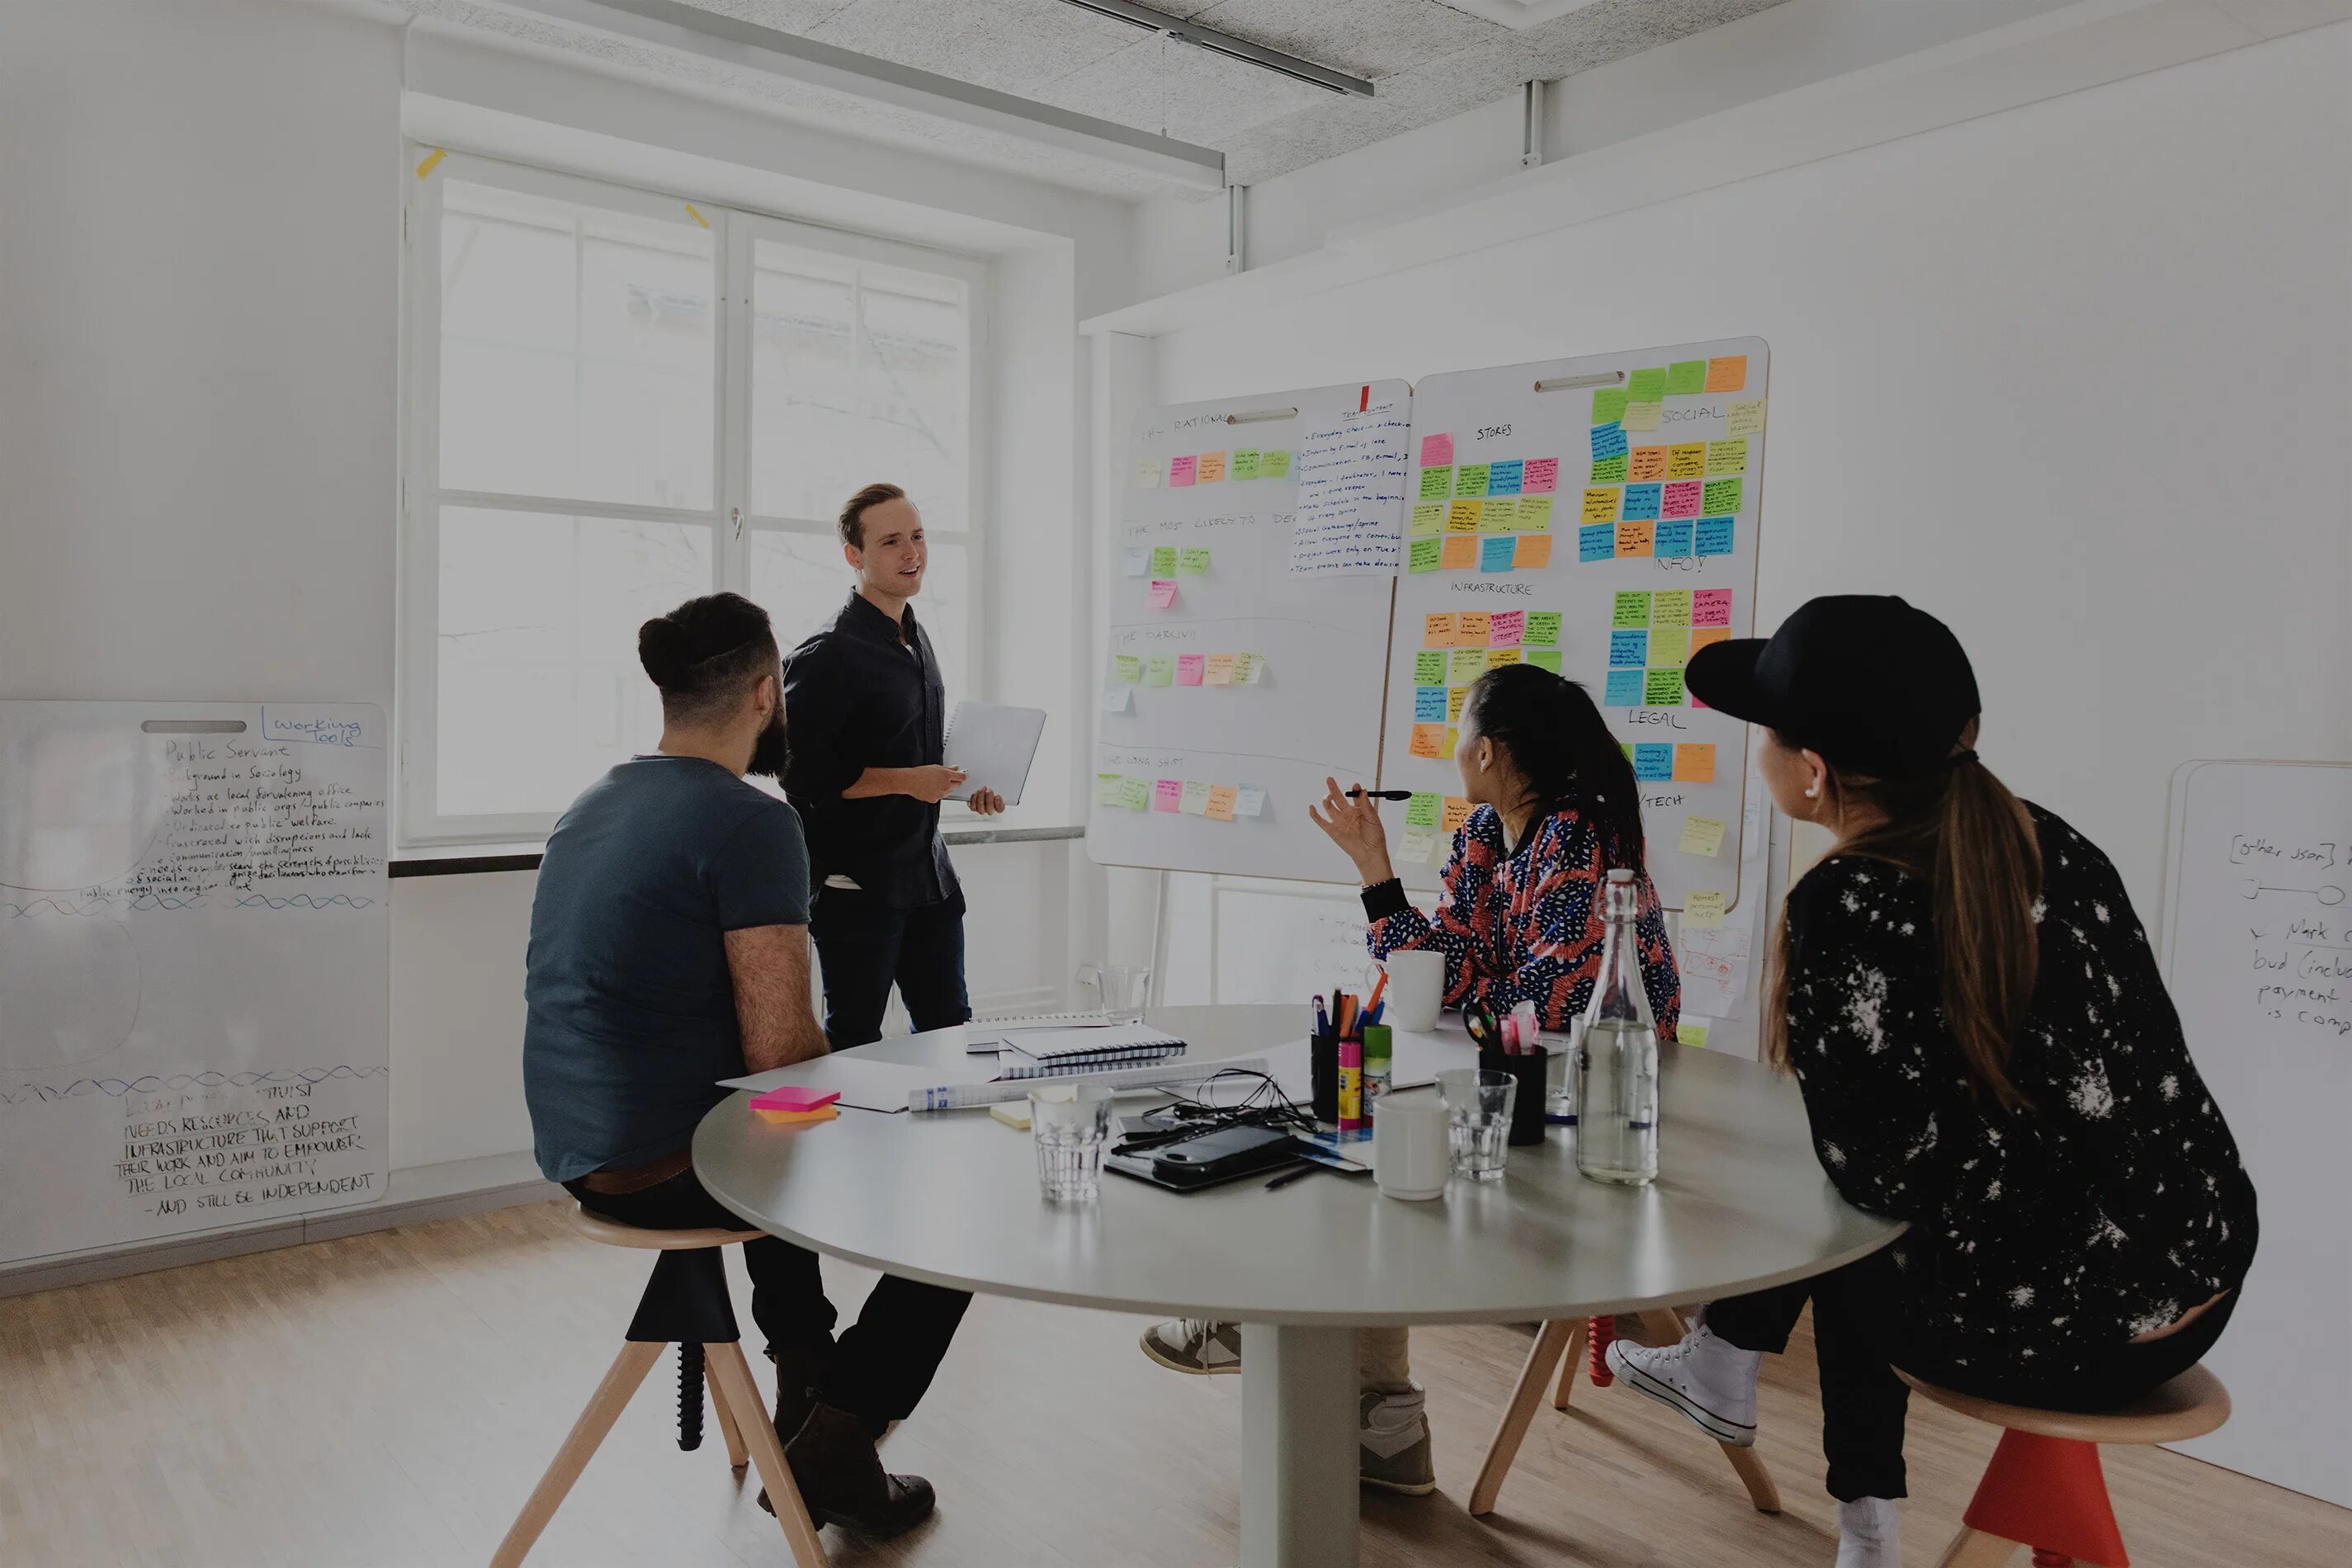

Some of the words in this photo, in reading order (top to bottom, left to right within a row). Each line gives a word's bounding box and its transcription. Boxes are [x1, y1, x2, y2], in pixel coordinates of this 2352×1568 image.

[1662, 405, 1726, 423] SOCIAL
[1476, 423, 1513, 440] STORES
[1451, 580, 1535, 596] INFRASTRUCTURE
[1628, 709, 1687, 730] LEGAL
[305, 729, 354, 747] Tools
[166, 739, 217, 761] Public
[225, 739, 290, 759] Servant
[249, 764, 301, 785] Sociology
[227, 786, 250, 801] local
[233, 800, 267, 819] public
[2287, 919, 2329, 940] Mark
[2254, 949, 2288, 971] bud
[2258, 985, 2341, 1005] payment
[276, 1104, 310, 1124] AND
[125, 1130, 250, 1160] INFRASTRUCTURE
[292, 1115, 360, 1140] SUPPORT
[113, 1160, 152, 1178] THEIR
[156, 1157, 191, 1173] WORK
[196, 1152, 225, 1169] AND
[229, 1150, 256, 1166] AIM
[261, 1146, 279, 1160] TO
[125, 1177, 155, 1194] THE
[164, 1172, 210, 1190] LOCAL
[219, 1158, 317, 1183] COMMUNITY
[196, 1193, 232, 1209] STILL
[262, 1172, 375, 1201] INDEPENDENT
